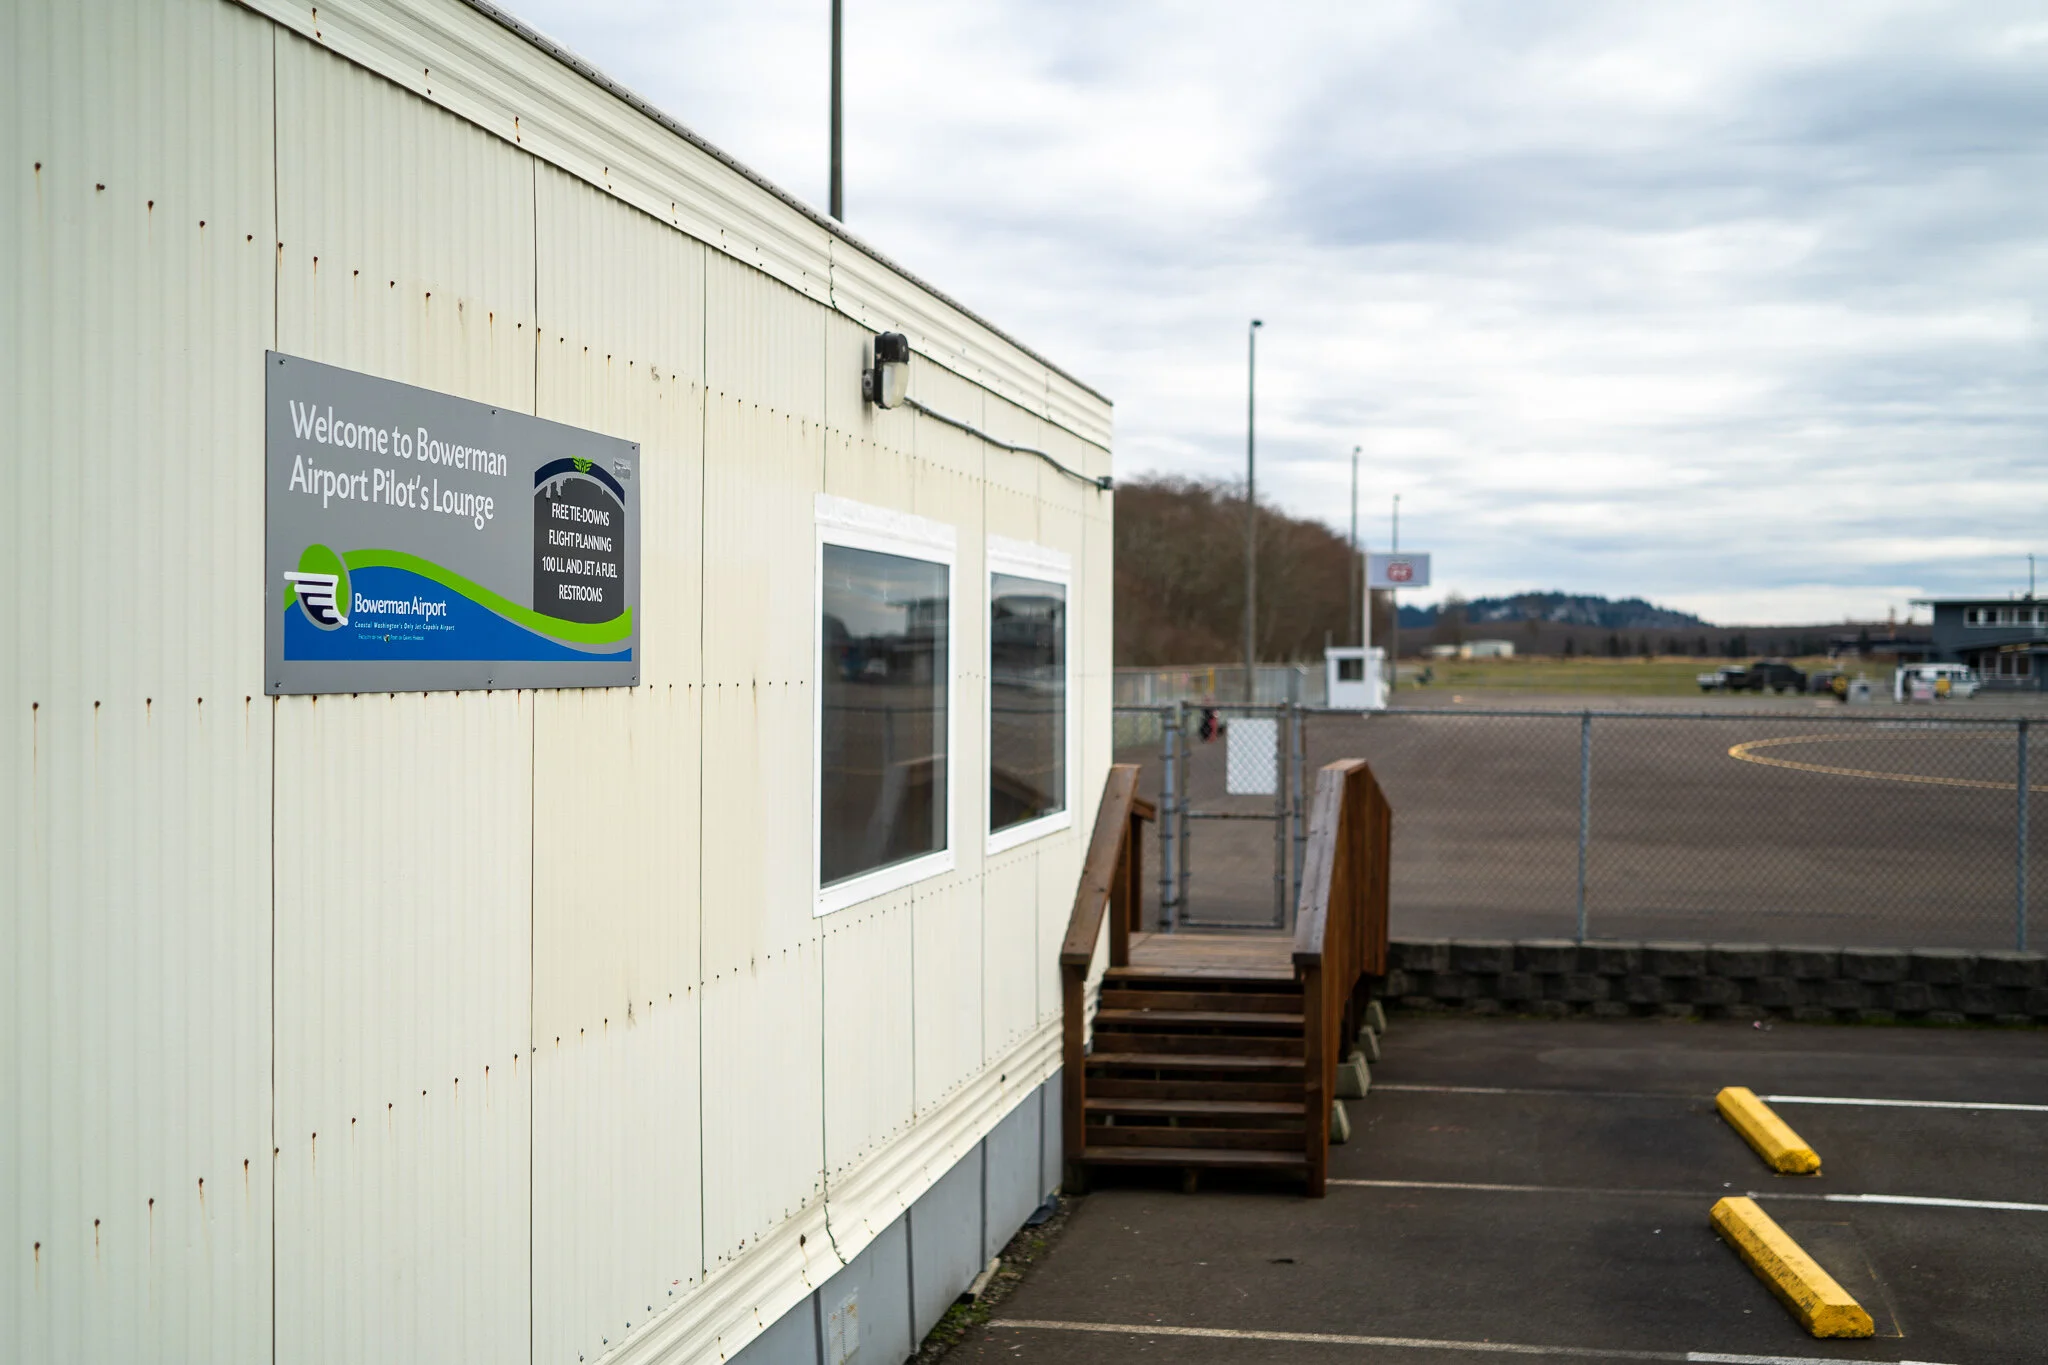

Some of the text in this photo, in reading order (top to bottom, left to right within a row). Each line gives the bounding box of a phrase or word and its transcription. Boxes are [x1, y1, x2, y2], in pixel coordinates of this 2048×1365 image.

[289, 400, 507, 477] Welcome to Bowerman
[289, 454, 494, 530] Airport Pilot's Lounge
[552, 502, 610, 526] FREE TIE-DOWNS
[549, 529, 612, 552] FLIGHT PLANNING
[542, 556, 556, 572] 100
[566, 558, 582, 574] AND
[583, 560, 595, 576] JET
[595, 562, 601, 577] A
[602, 562, 618, 578] FUEL
[559, 584, 603, 603] RESTROOMS
[355, 593, 447, 622] Bowerman Airport
